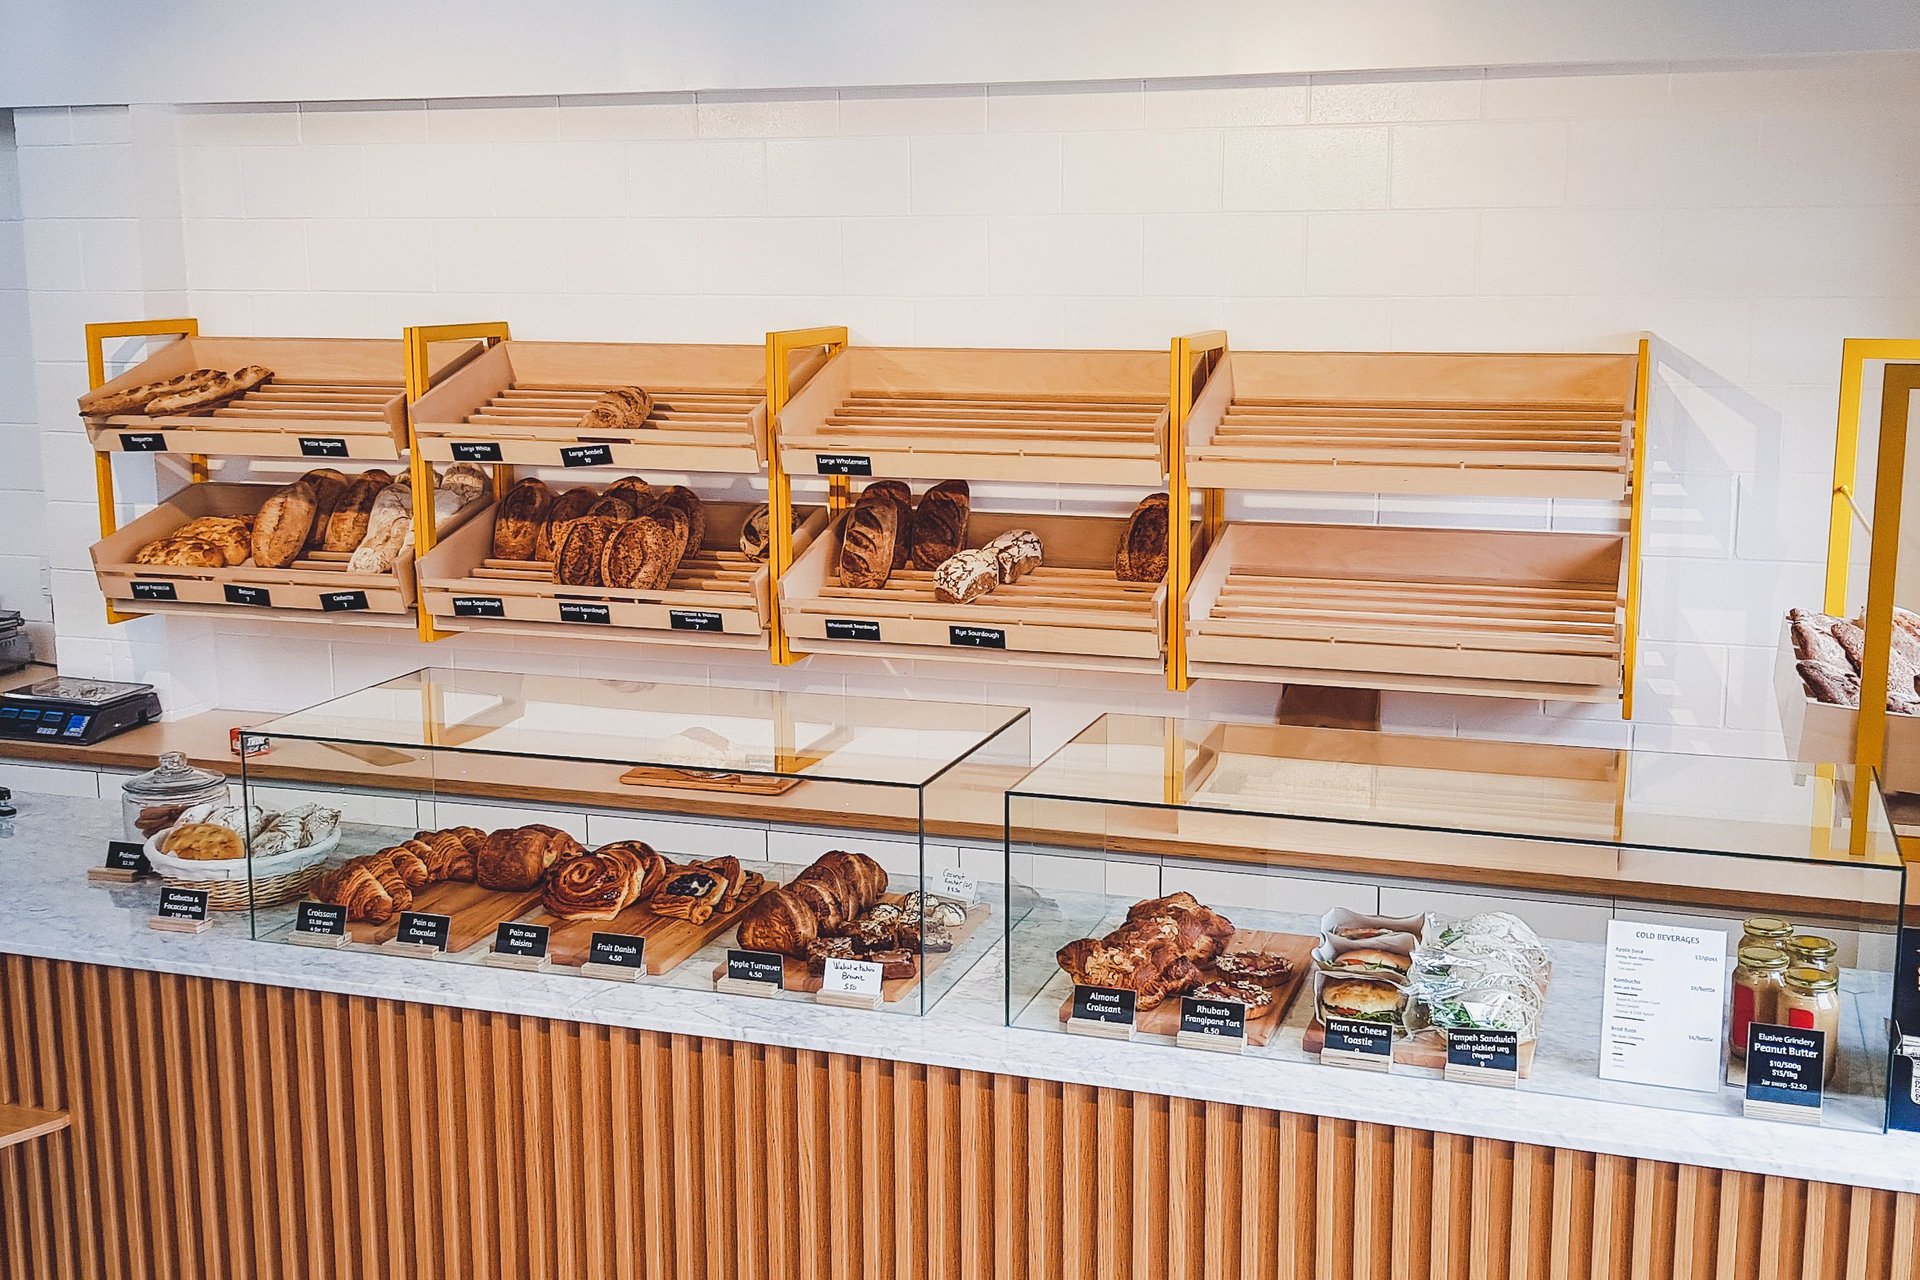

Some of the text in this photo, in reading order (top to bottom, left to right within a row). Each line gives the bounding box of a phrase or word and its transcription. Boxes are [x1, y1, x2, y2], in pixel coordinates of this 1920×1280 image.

[580, 606, 608, 614] Sourdough
[968, 630, 1000, 639] Sourdough
[169, 894, 193, 902] Ciabatta
[164, 902, 188, 910] Focaccia
[307, 908, 337, 918] Croissant
[412, 918, 426, 926] Pain
[409, 928, 436, 938] Chocolat
[509, 928, 524, 936] Pain
[1636, 931, 1700, 944] COLD BEVERAGES
[510, 938, 532, 948] Raisins
[597, 943, 636, 954] Fruit Danish
[730, 960, 780, 971] Apple Turnover
[1090, 992, 1120, 1002] Almond
[1086, 1002, 1121, 1014] Croissant
[1196, 1004, 1230, 1016] Rhubarb
[1184, 1014, 1240, 1028] Frangipane Tart
[1330, 1022, 1350, 1032] Ham
[1359, 1026, 1388, 1036] Cheese
[1342, 1034, 1373, 1046] Toastie
[1448, 1032, 1516, 1044] Tempeh Sandwich
[1758, 1032, 1815, 1048] Elusive Grindery
[1472, 1044, 1496, 1052] pickled
[1496, 1046, 1510, 1054] veg
[1754, 1042, 1818, 1058] Peanut Butter
[1769, 1060, 1802, 1072] $10/500g
[1772, 1069, 1798, 1080] $15/1kg
